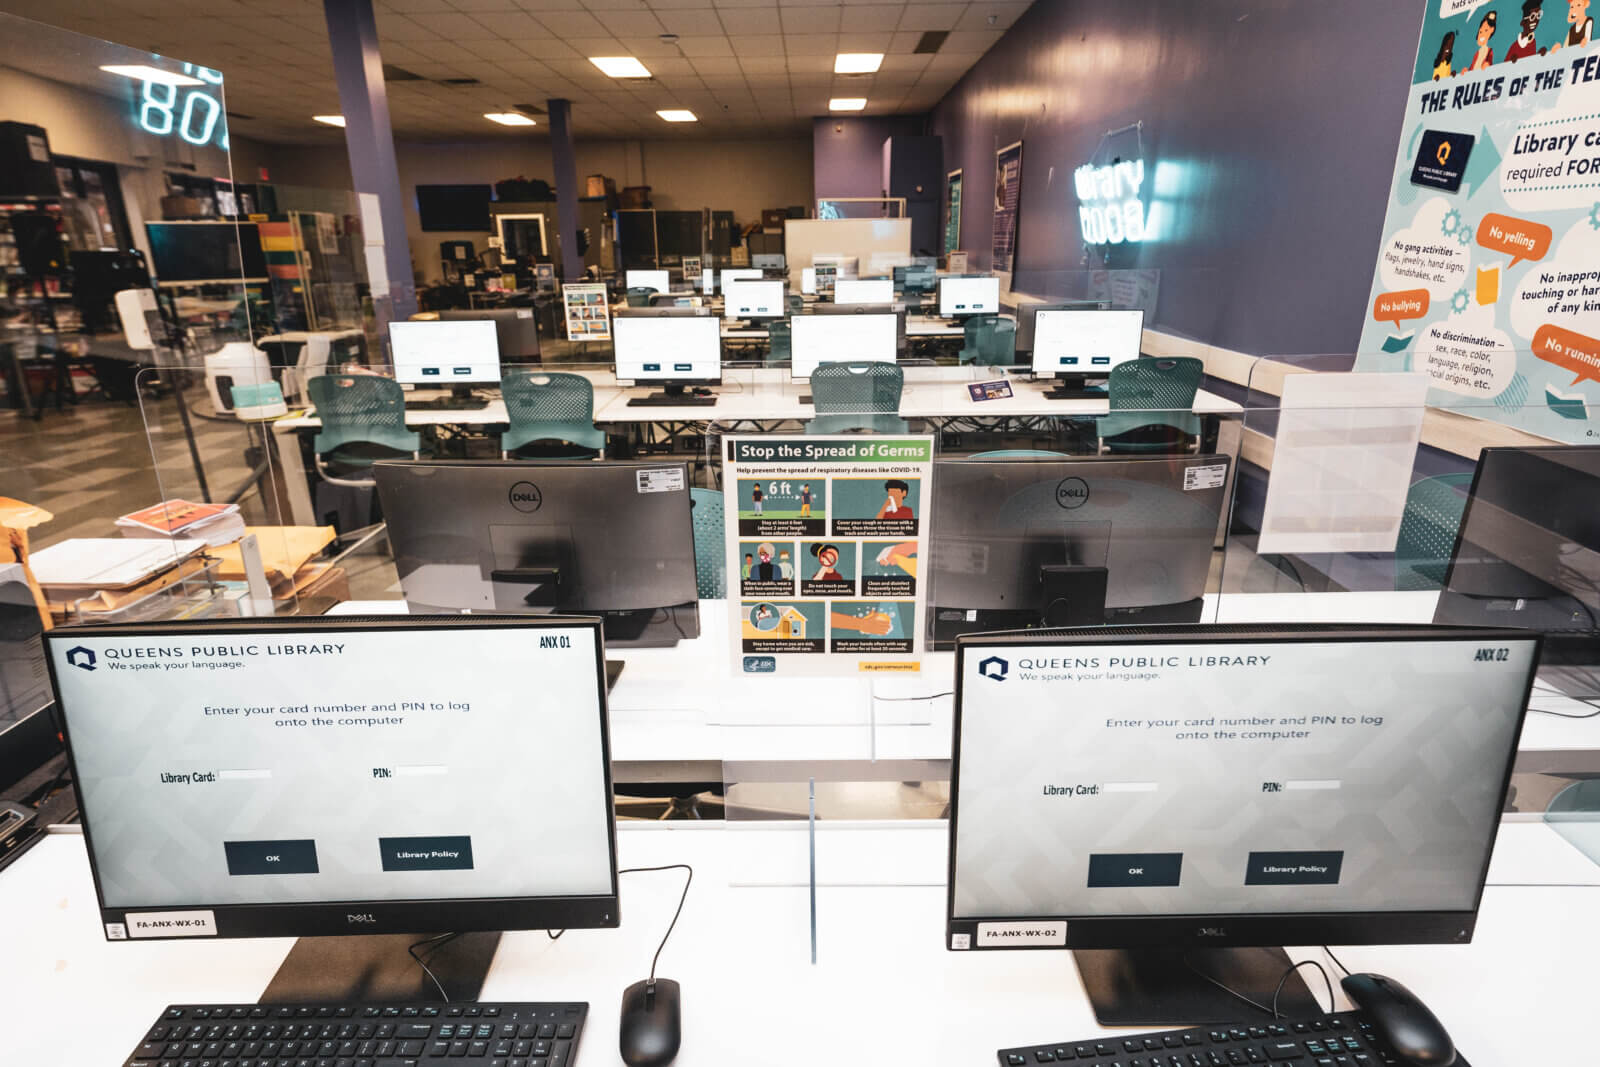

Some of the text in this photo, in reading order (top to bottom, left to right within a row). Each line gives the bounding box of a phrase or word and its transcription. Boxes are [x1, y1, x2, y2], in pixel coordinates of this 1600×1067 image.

[1421, 89, 1449, 114] THE
[1452, 77, 1505, 110] RULES
[1509, 76, 1529, 97] OF
[1535, 68, 1564, 92] THE
[1514, 134, 1579, 156] Library
[1507, 161, 1563, 184] required
[1489, 226, 1536, 251] No yelling
[1394, 241, 1403, 250] No
[1405, 244, 1421, 255] gang
[1423, 246, 1453, 257] activities
[1402, 254, 1426, 267] jewelry,
[1428, 259, 1444, 269] hand
[1446, 262, 1465, 273] signs,
[1395, 266, 1446, 283] handshakes, etc.
[1540, 273, 1554, 284] No
[1522, 288, 1564, 300] touching
[1567, 288, 1578, 297] or
[1381, 300, 1421, 313] No bullying
[1548, 302, 1560, 313] of
[1561, 304, 1580, 315] any
[1430, 329, 1441, 338] No
[1443, 331, 1495, 348] discrimination
[1545, 336, 1562, 352] No
[1436, 344, 1491, 363] sex, race, color,
[1462, 363, 1494, 377] religion,
[1445, 374, 1472, 386] origins,
[1474, 380, 1491, 390] etc.
[741, 444, 925, 460] Stop the Spread of Germs
[769, 482, 791, 495] 6 ft
[1060, 489, 1085, 497] DELL
[514, 493, 538, 502] DELL
[540, 636, 571, 649] ANX 01
[104, 644, 346, 659] QUEENS PUBLIC LIBRARY
[1474, 648, 1509, 662] ANX 02
[108, 660, 246, 672] We speak your language.
[1018, 655, 1272, 669] QUEENS PUBLIC LIBRARY
[1019, 671, 1161, 682] We speak your language.
[204, 701, 470, 717] Enter your card number and PIN to log
[275, 716, 404, 728] onto the computer
[1106, 715, 1384, 729] Enter your card number and PIN to log
[1176, 730, 1310, 741] onto the computer
[160, 771, 216, 785] Library Card:
[373, 768, 392, 778] PIN:
[1043, 784, 1100, 797] Library Card:
[1262, 782, 1282, 792] PIN:
[397, 850, 459, 859] Library Policy
[1263, 865, 1328, 874] Library Policy
[136, 920, 206, 929] FA-ANX-WX-01
[347, 914, 376, 922] DELL
[986, 930, 1057, 938] FA-ANX-WX-02
